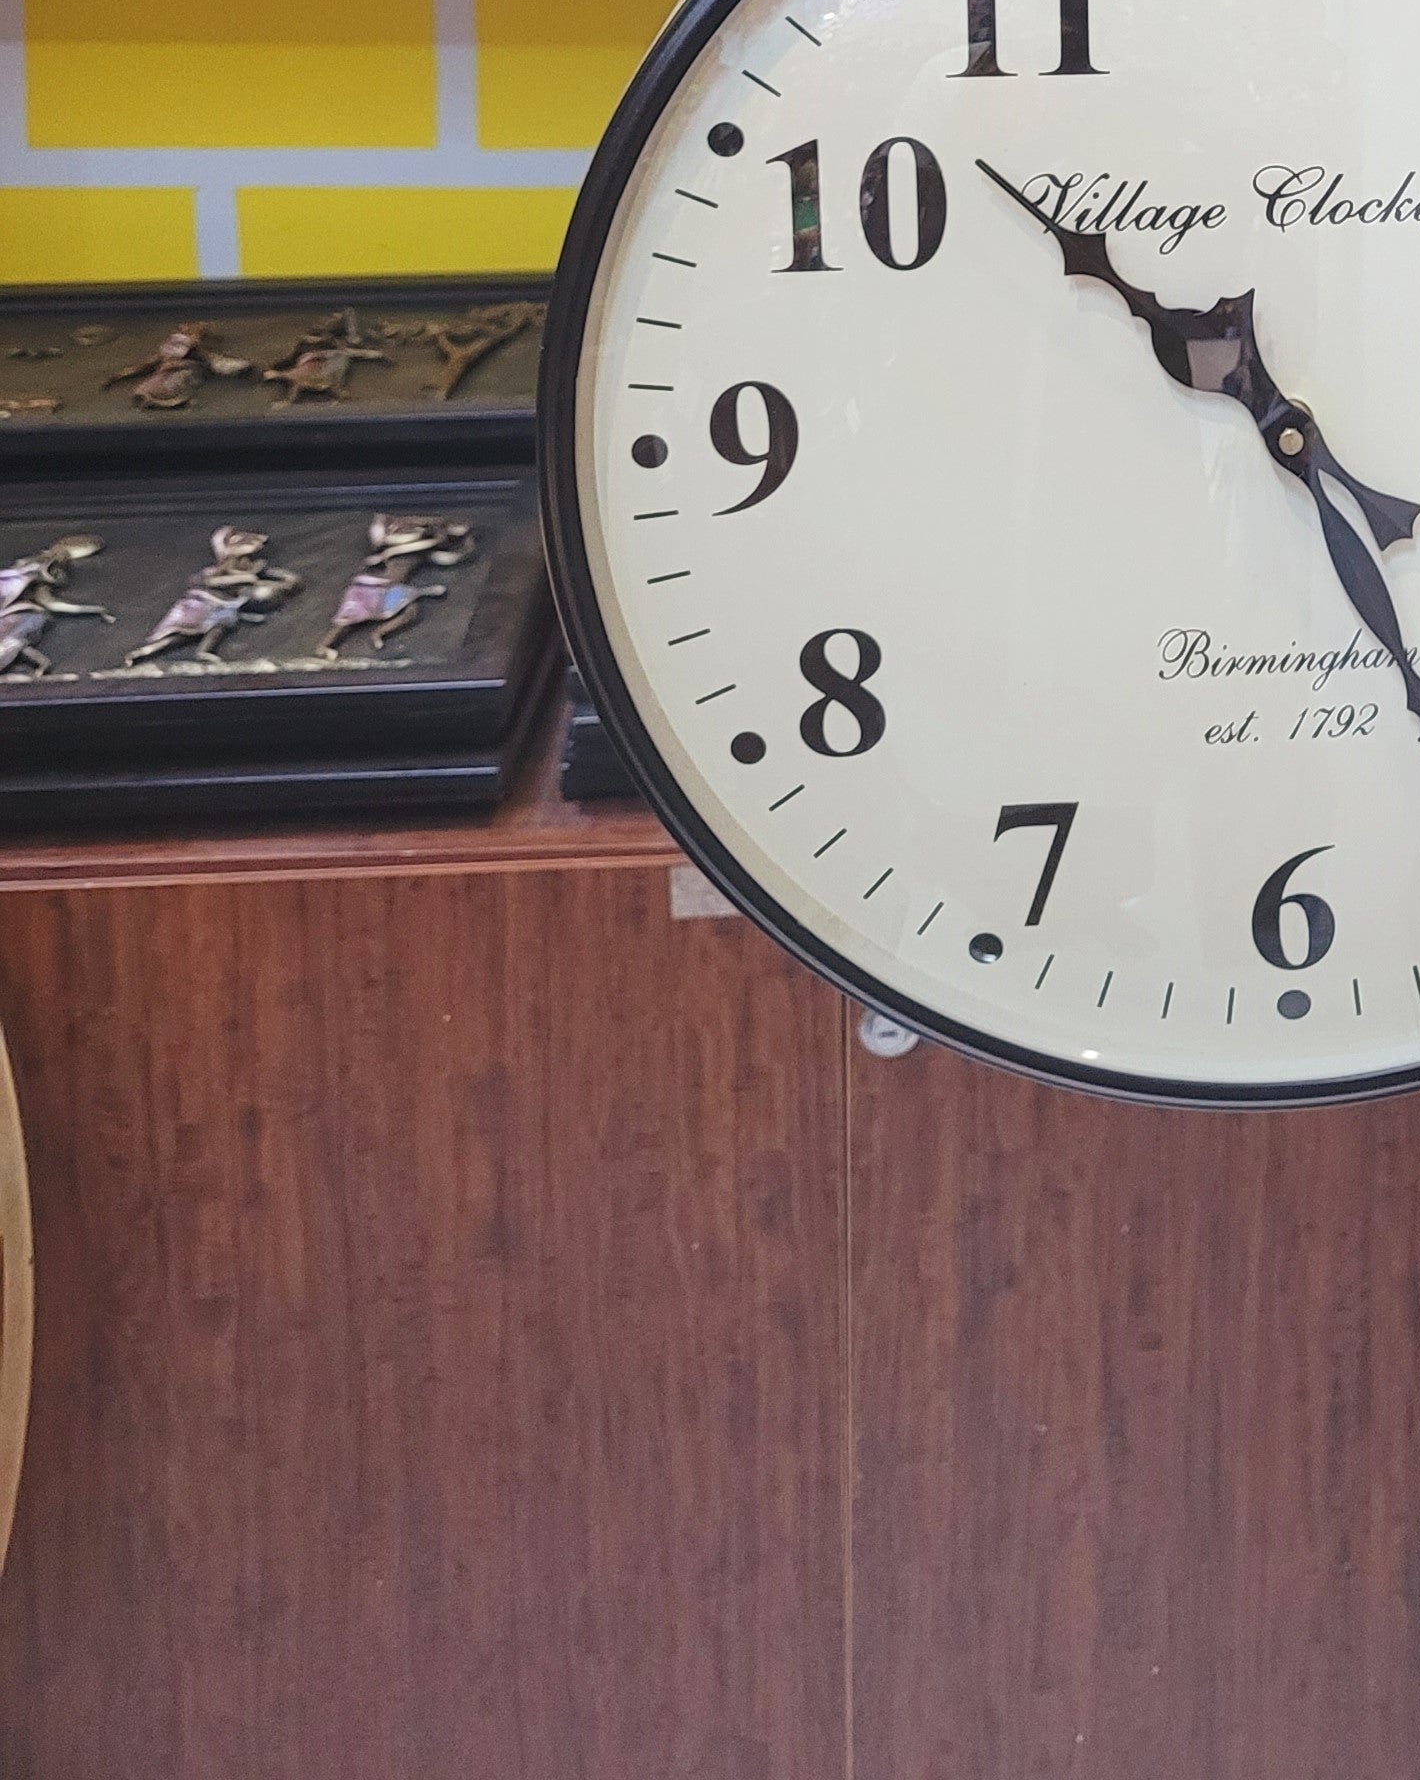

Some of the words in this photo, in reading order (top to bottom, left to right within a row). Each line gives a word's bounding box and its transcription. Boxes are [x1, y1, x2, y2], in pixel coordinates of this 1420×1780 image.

[764, 136, 948, 274] 10
[1018, 172, 1228, 255] Village
[708, 380, 800, 517] 9
[798, 627, 887, 759] 8
[1204, 710, 1260, 745] est.
[1288, 702, 1380, 741] 1792
[992, 800, 1080, 928] 7
[1250, 844, 1337, 972] 6
